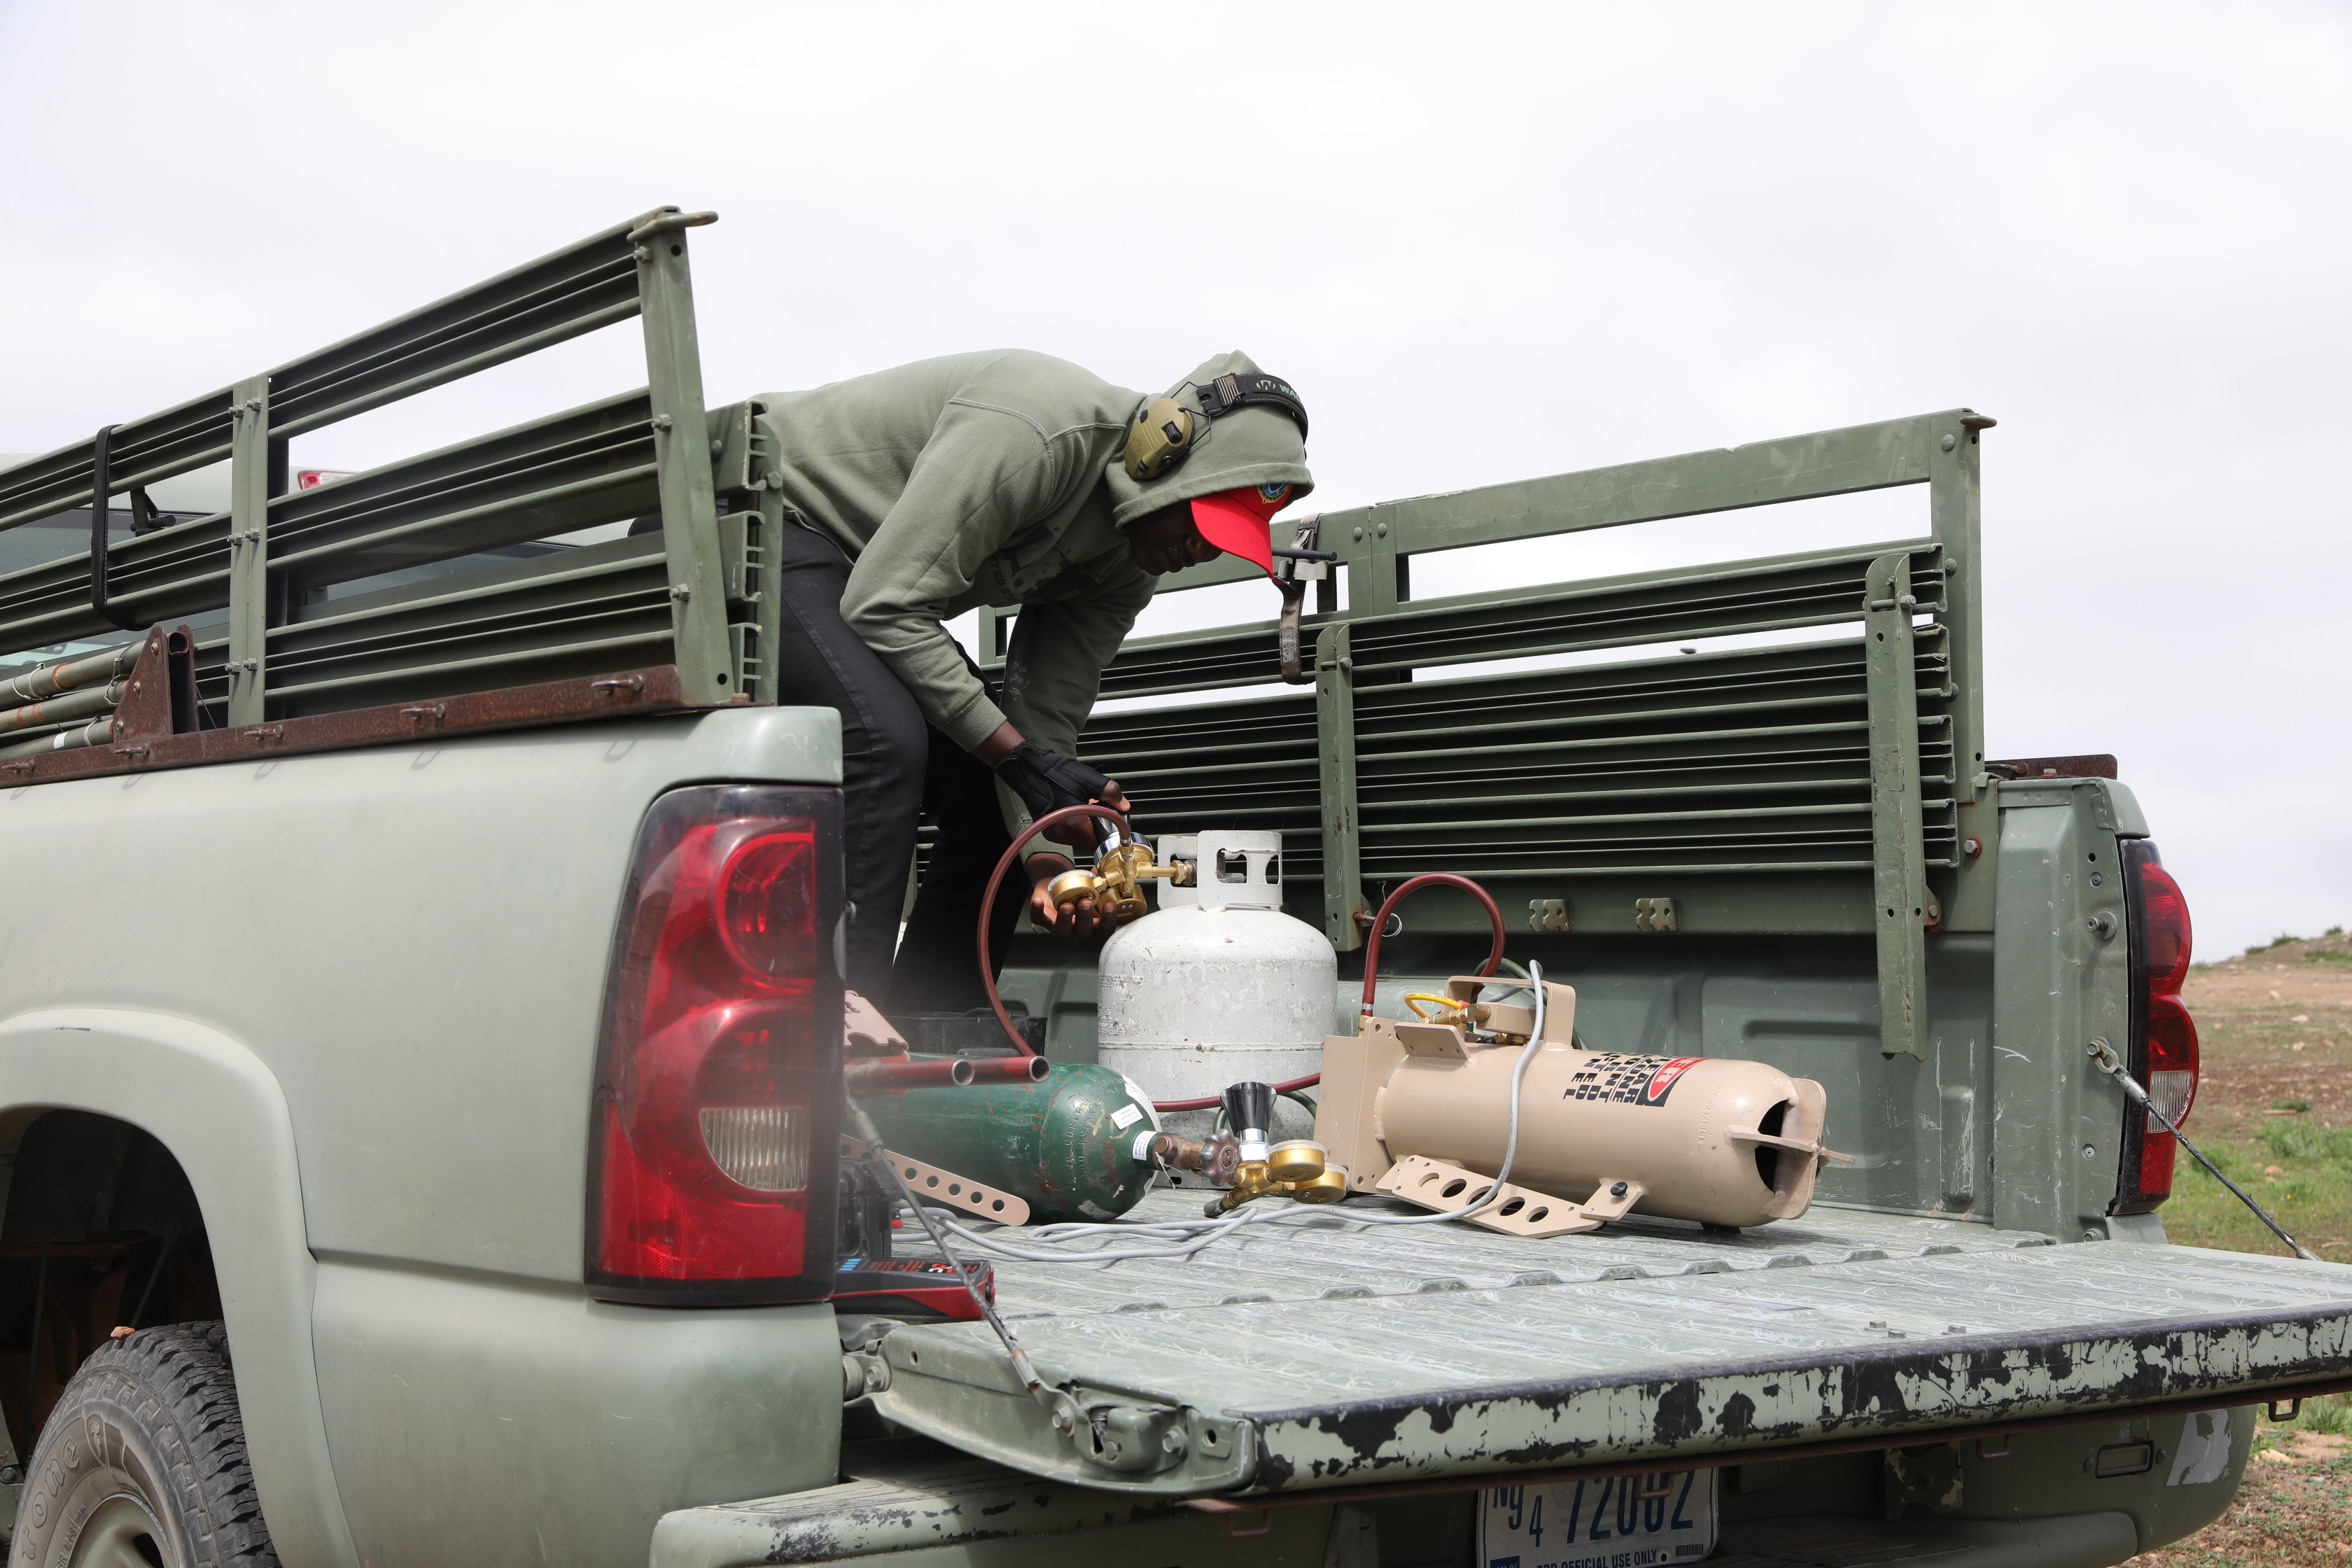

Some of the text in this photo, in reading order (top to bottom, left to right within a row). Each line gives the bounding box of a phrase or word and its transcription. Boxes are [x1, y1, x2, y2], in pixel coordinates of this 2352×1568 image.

[1598, 1058, 1638, 1104] OINT
[1623, 1058, 1672, 1104] LEAR
[1611, 1552, 1631, 1568] USE
[1634, 1548, 1658, 1564] ONLY
